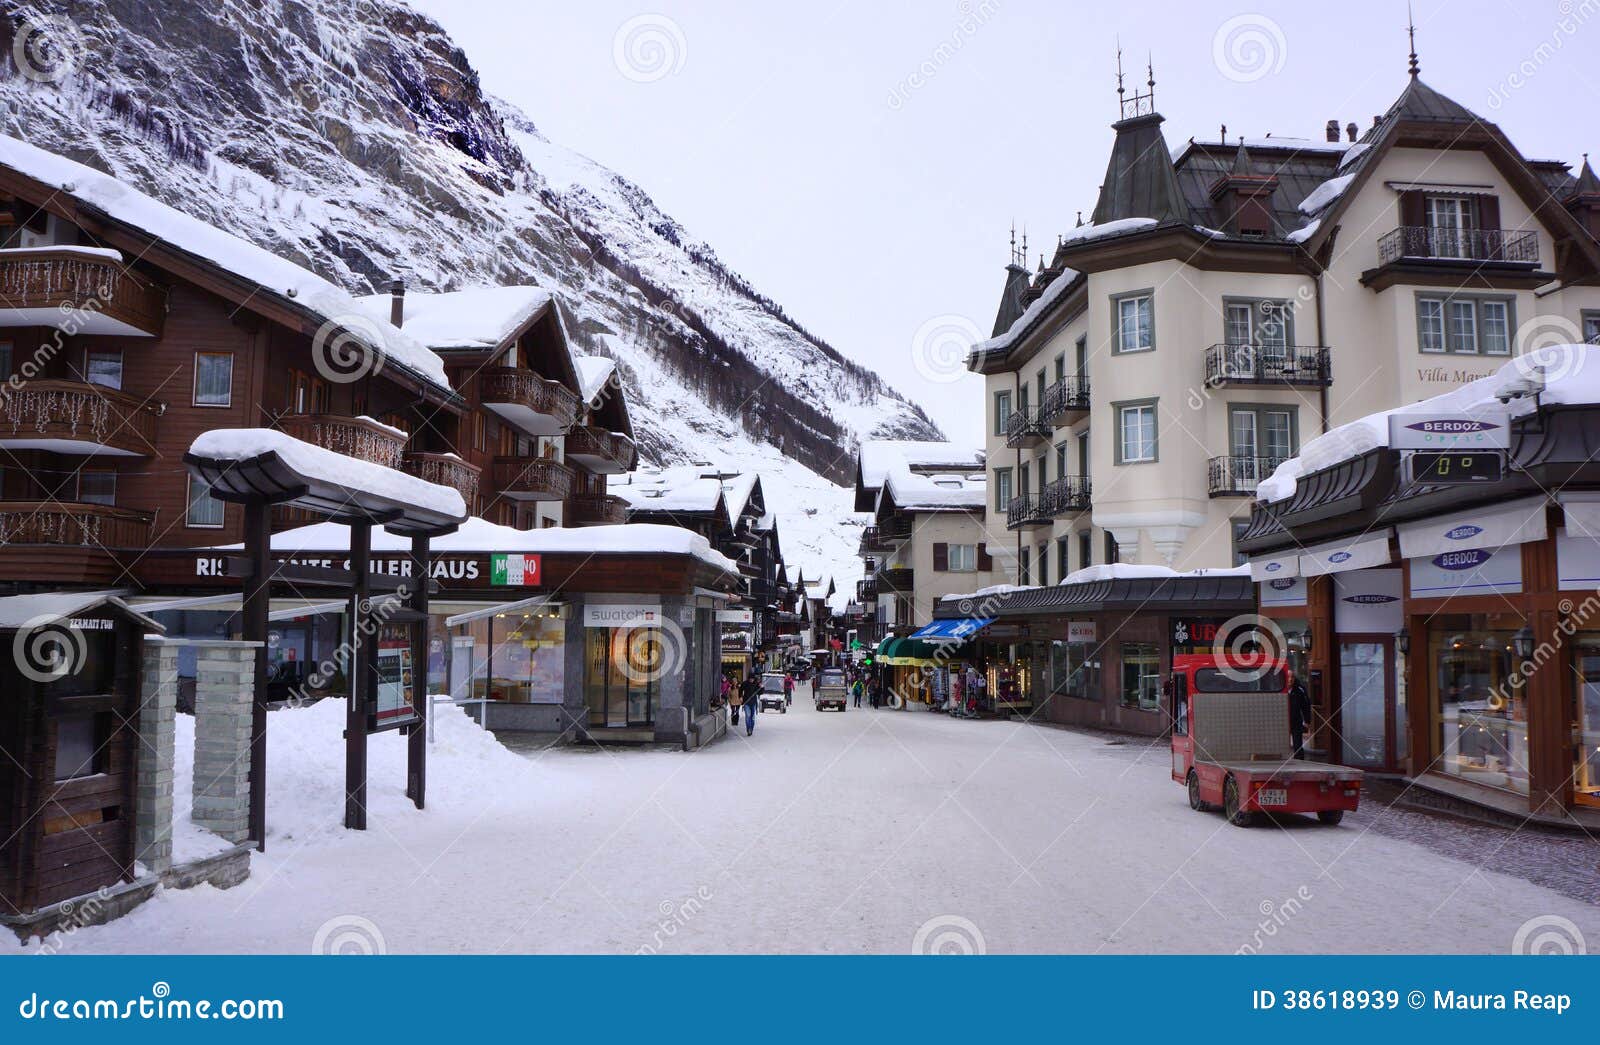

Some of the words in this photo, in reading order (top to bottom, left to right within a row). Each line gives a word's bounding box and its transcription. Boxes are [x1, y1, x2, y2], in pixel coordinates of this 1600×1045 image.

[1418, 367, 1448, 382] Villa
[1424, 422, 1481, 431] BERDOZ
[1442, 551, 1479, 566] BERDOZ
[591, 609, 644, 621] swatch
